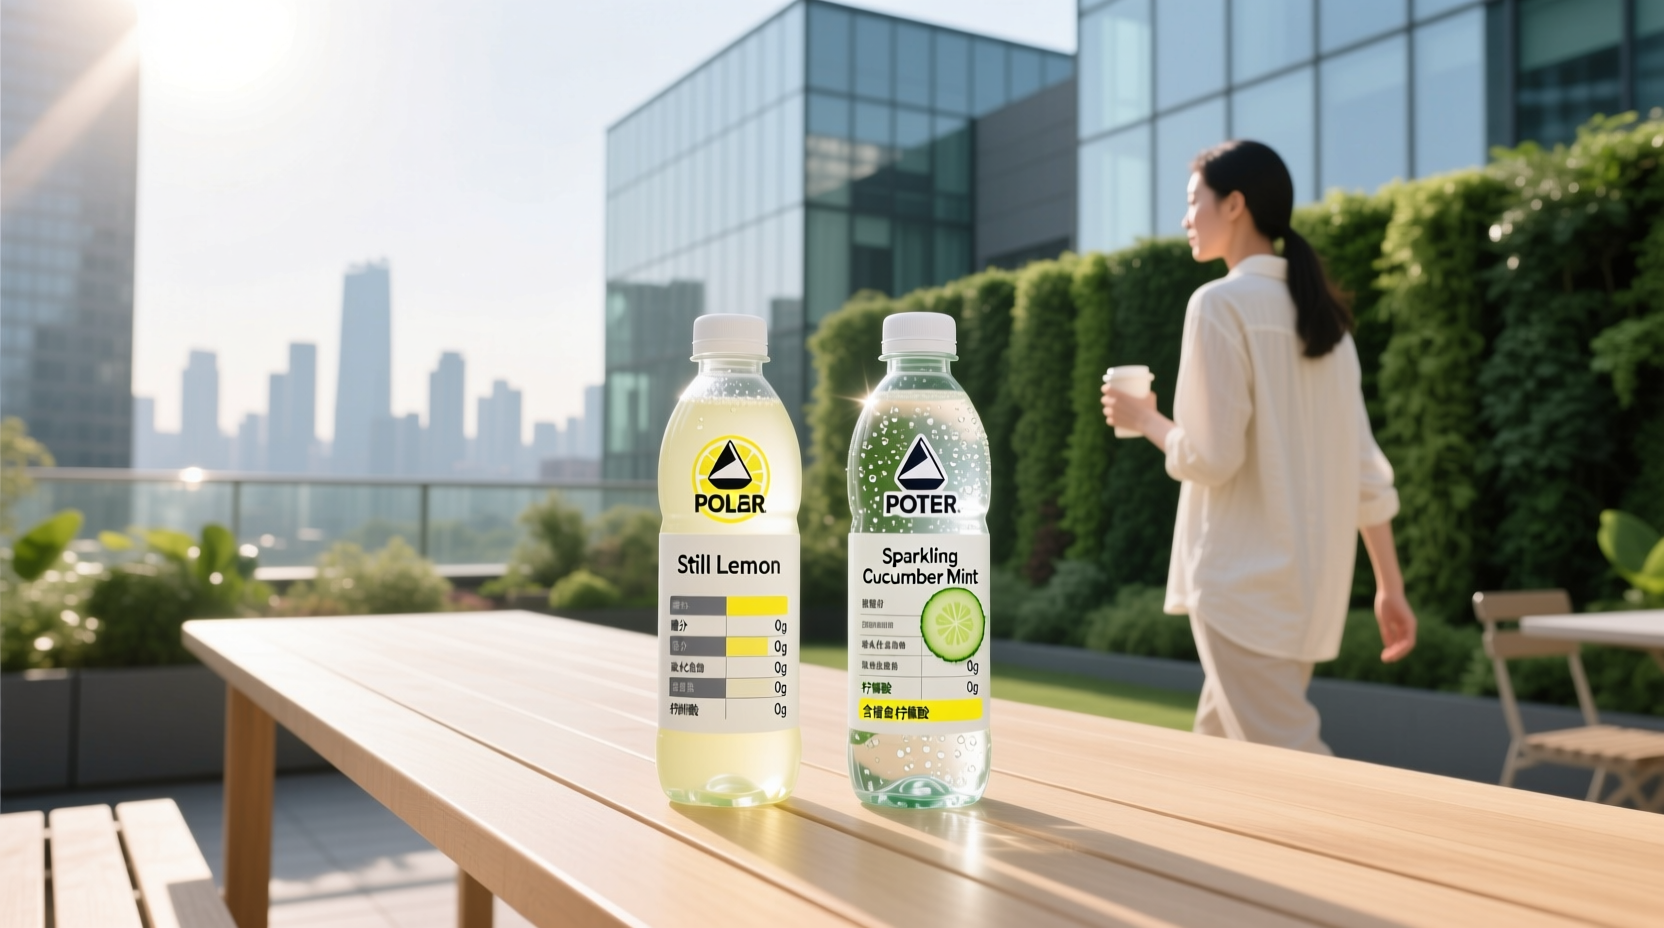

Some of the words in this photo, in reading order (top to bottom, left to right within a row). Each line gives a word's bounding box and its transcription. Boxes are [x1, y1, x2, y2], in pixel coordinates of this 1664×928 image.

[886, 494, 957, 514] POTER
[677, 553, 711, 574] Still
[717, 554, 781, 574] Lemon
[882, 547, 958, 567] Sparkling
[863, 568, 944, 584] Cucumber
[947, 568, 979, 584] Mint
[775, 619, 787, 634] 0g
[774, 640, 787, 656] 0g
[774, 661, 787, 676] 0g
[967, 660, 979, 675] 0g
[774, 681, 787, 697] 0g
[966, 681, 979, 695] 0g
[774, 702, 787, 718] 0g
